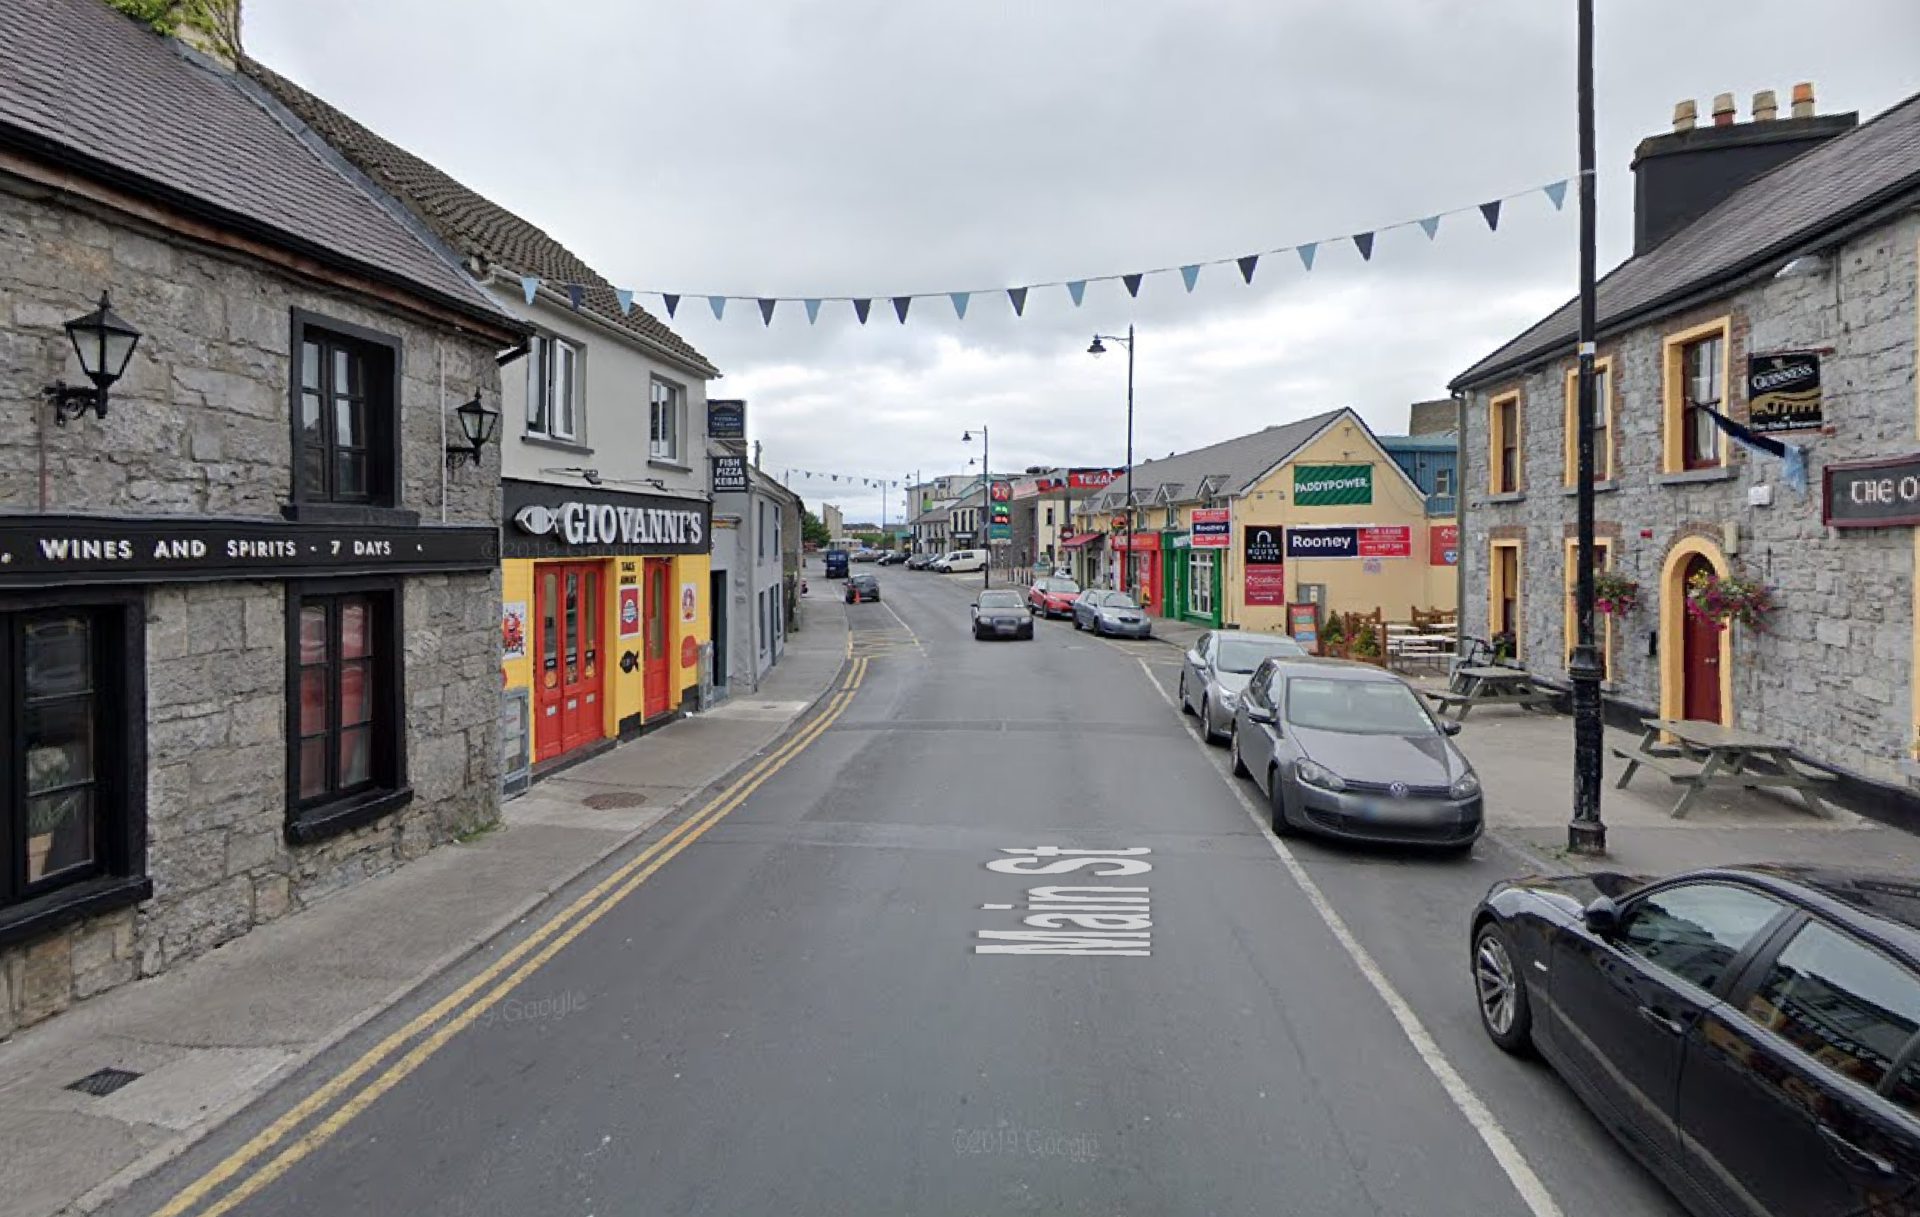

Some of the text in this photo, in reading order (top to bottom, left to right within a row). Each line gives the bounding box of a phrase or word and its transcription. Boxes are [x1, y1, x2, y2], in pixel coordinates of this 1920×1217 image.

[719, 458, 740, 467] FISH
[716, 467, 743, 477] PIZZA
[714, 476, 745, 486] KEBAB
[1078, 473, 1117, 486] TEXAC
[1899, 475, 1920, 500] O
[563, 502, 703, 545] GIOVANNI'S
[1292, 534, 1351, 549] Rooney
[40, 538, 393, 561] WINES AND SPIRITS 7 DAYS
